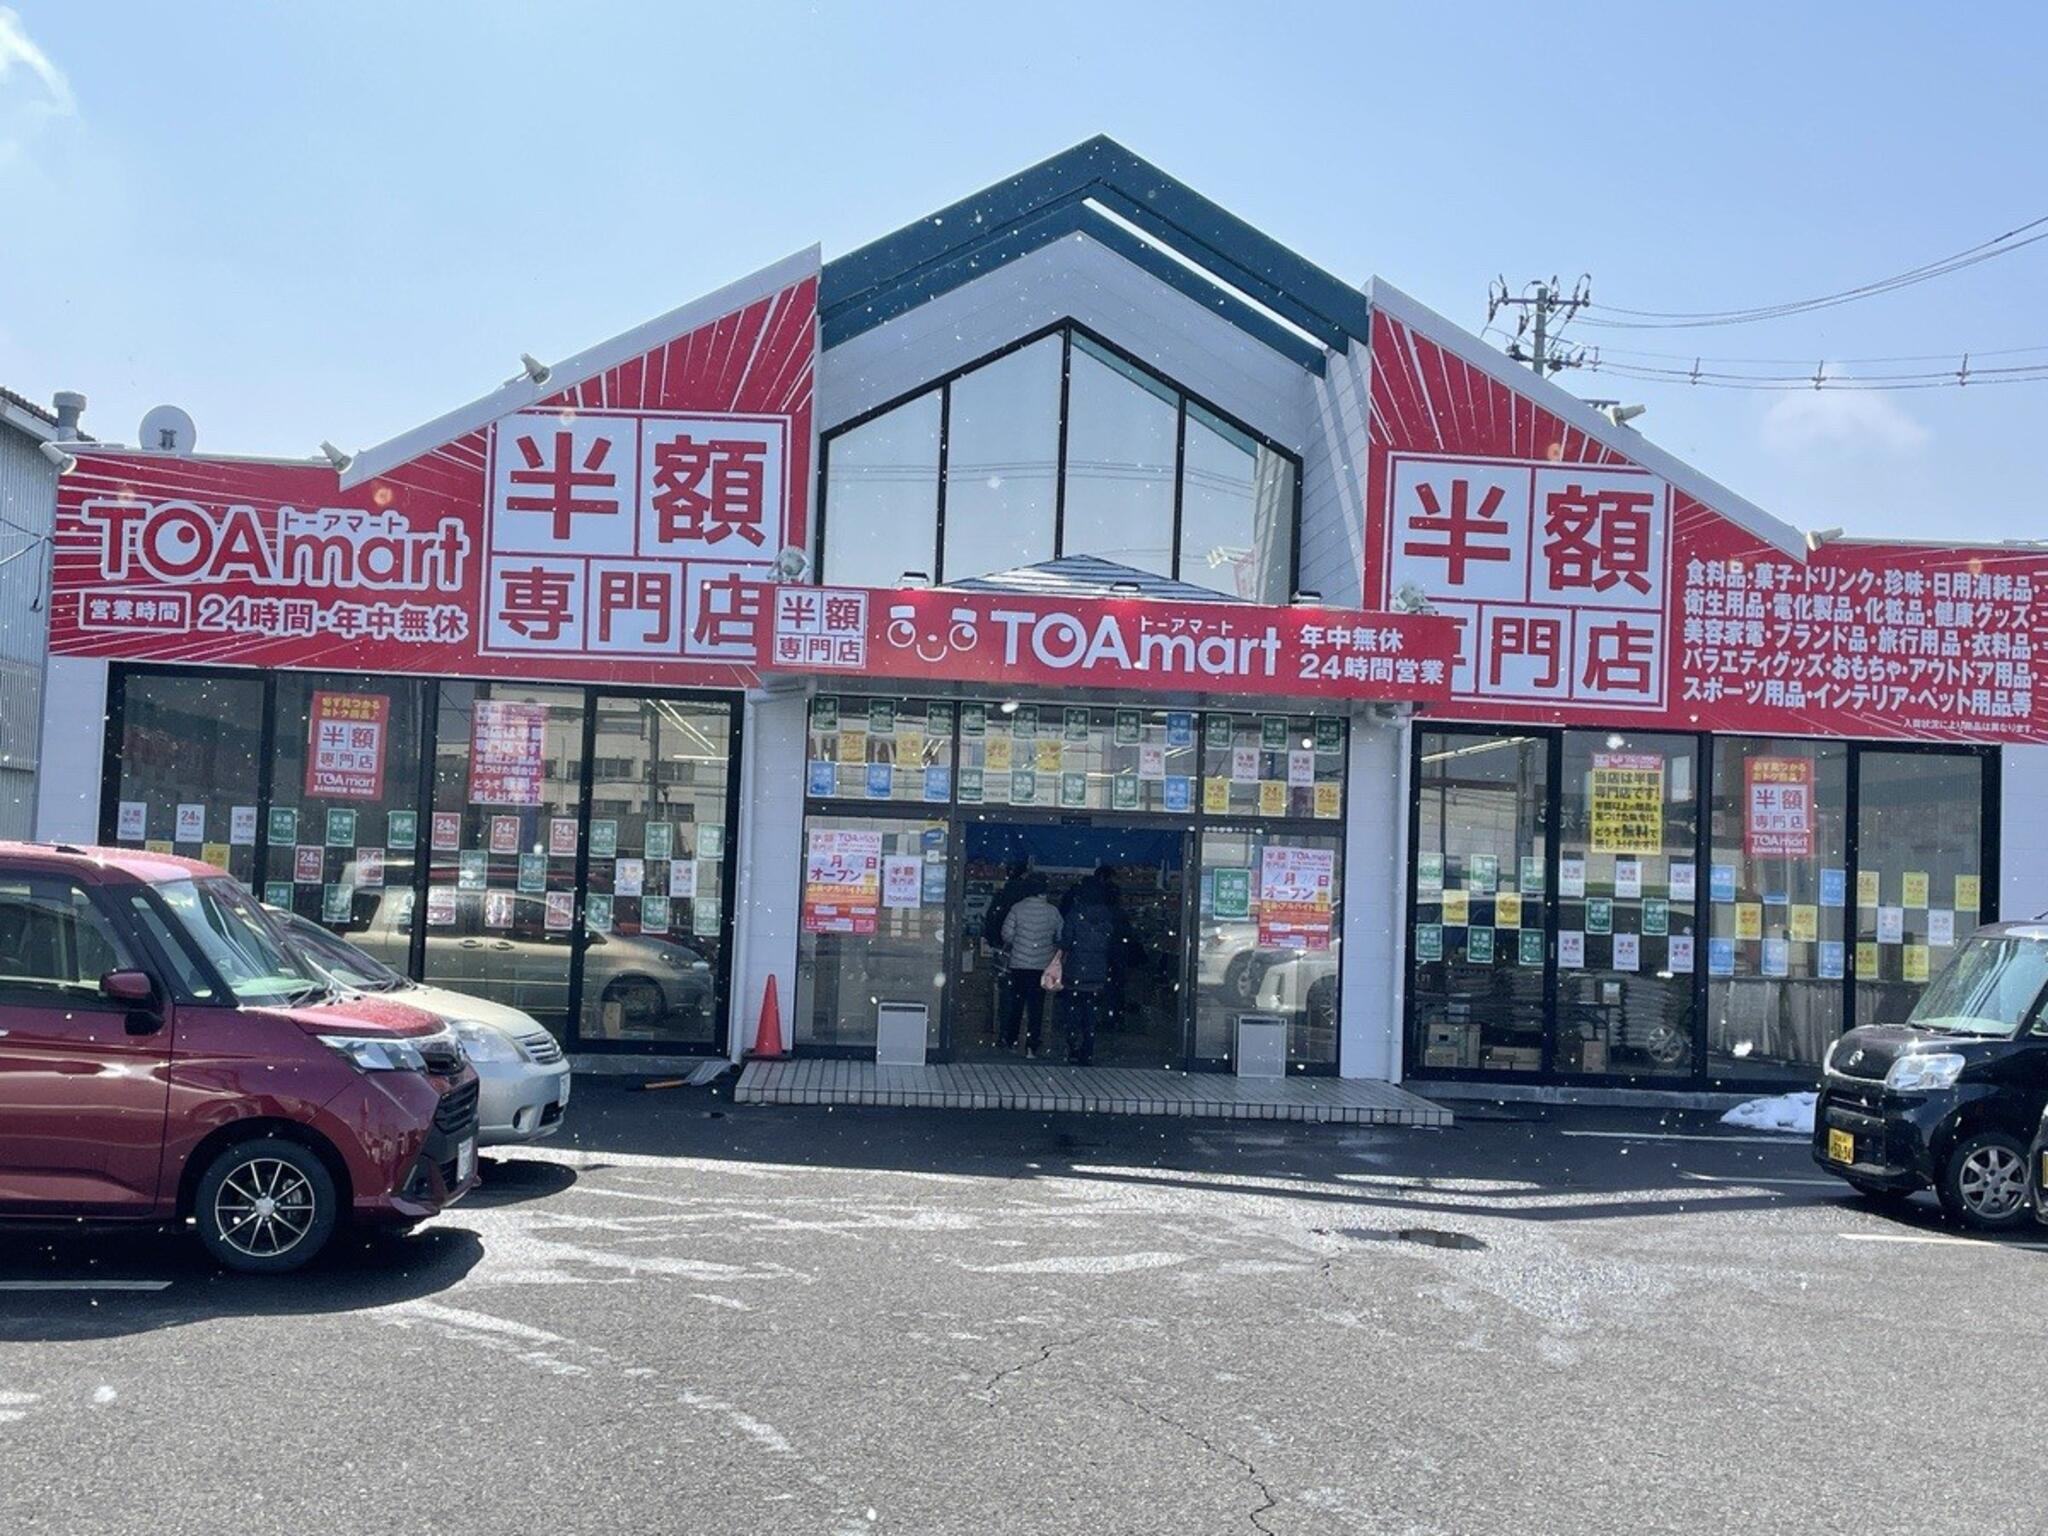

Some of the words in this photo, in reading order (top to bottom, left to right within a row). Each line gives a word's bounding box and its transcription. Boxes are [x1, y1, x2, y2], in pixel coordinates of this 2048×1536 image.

[506, 431, 768, 547] 半額
[282, 511, 405, 534] トーアマート
[1403, 479, 1655, 595] 半額
[89, 599, 180, 624] 営業時間
[499, 566, 761, 647] 専門店
[780, 596, 861, 632] 半額
[1140, 617, 1235, 636] トーアマート
[1300, 625, 1403, 653] 年中無休
[778, 636, 861, 664] 専門店
[1299, 653, 1444, 686] 24時間営業
[322, 726, 375, 749] 半額
[1756, 789, 1803, 810] 半額
